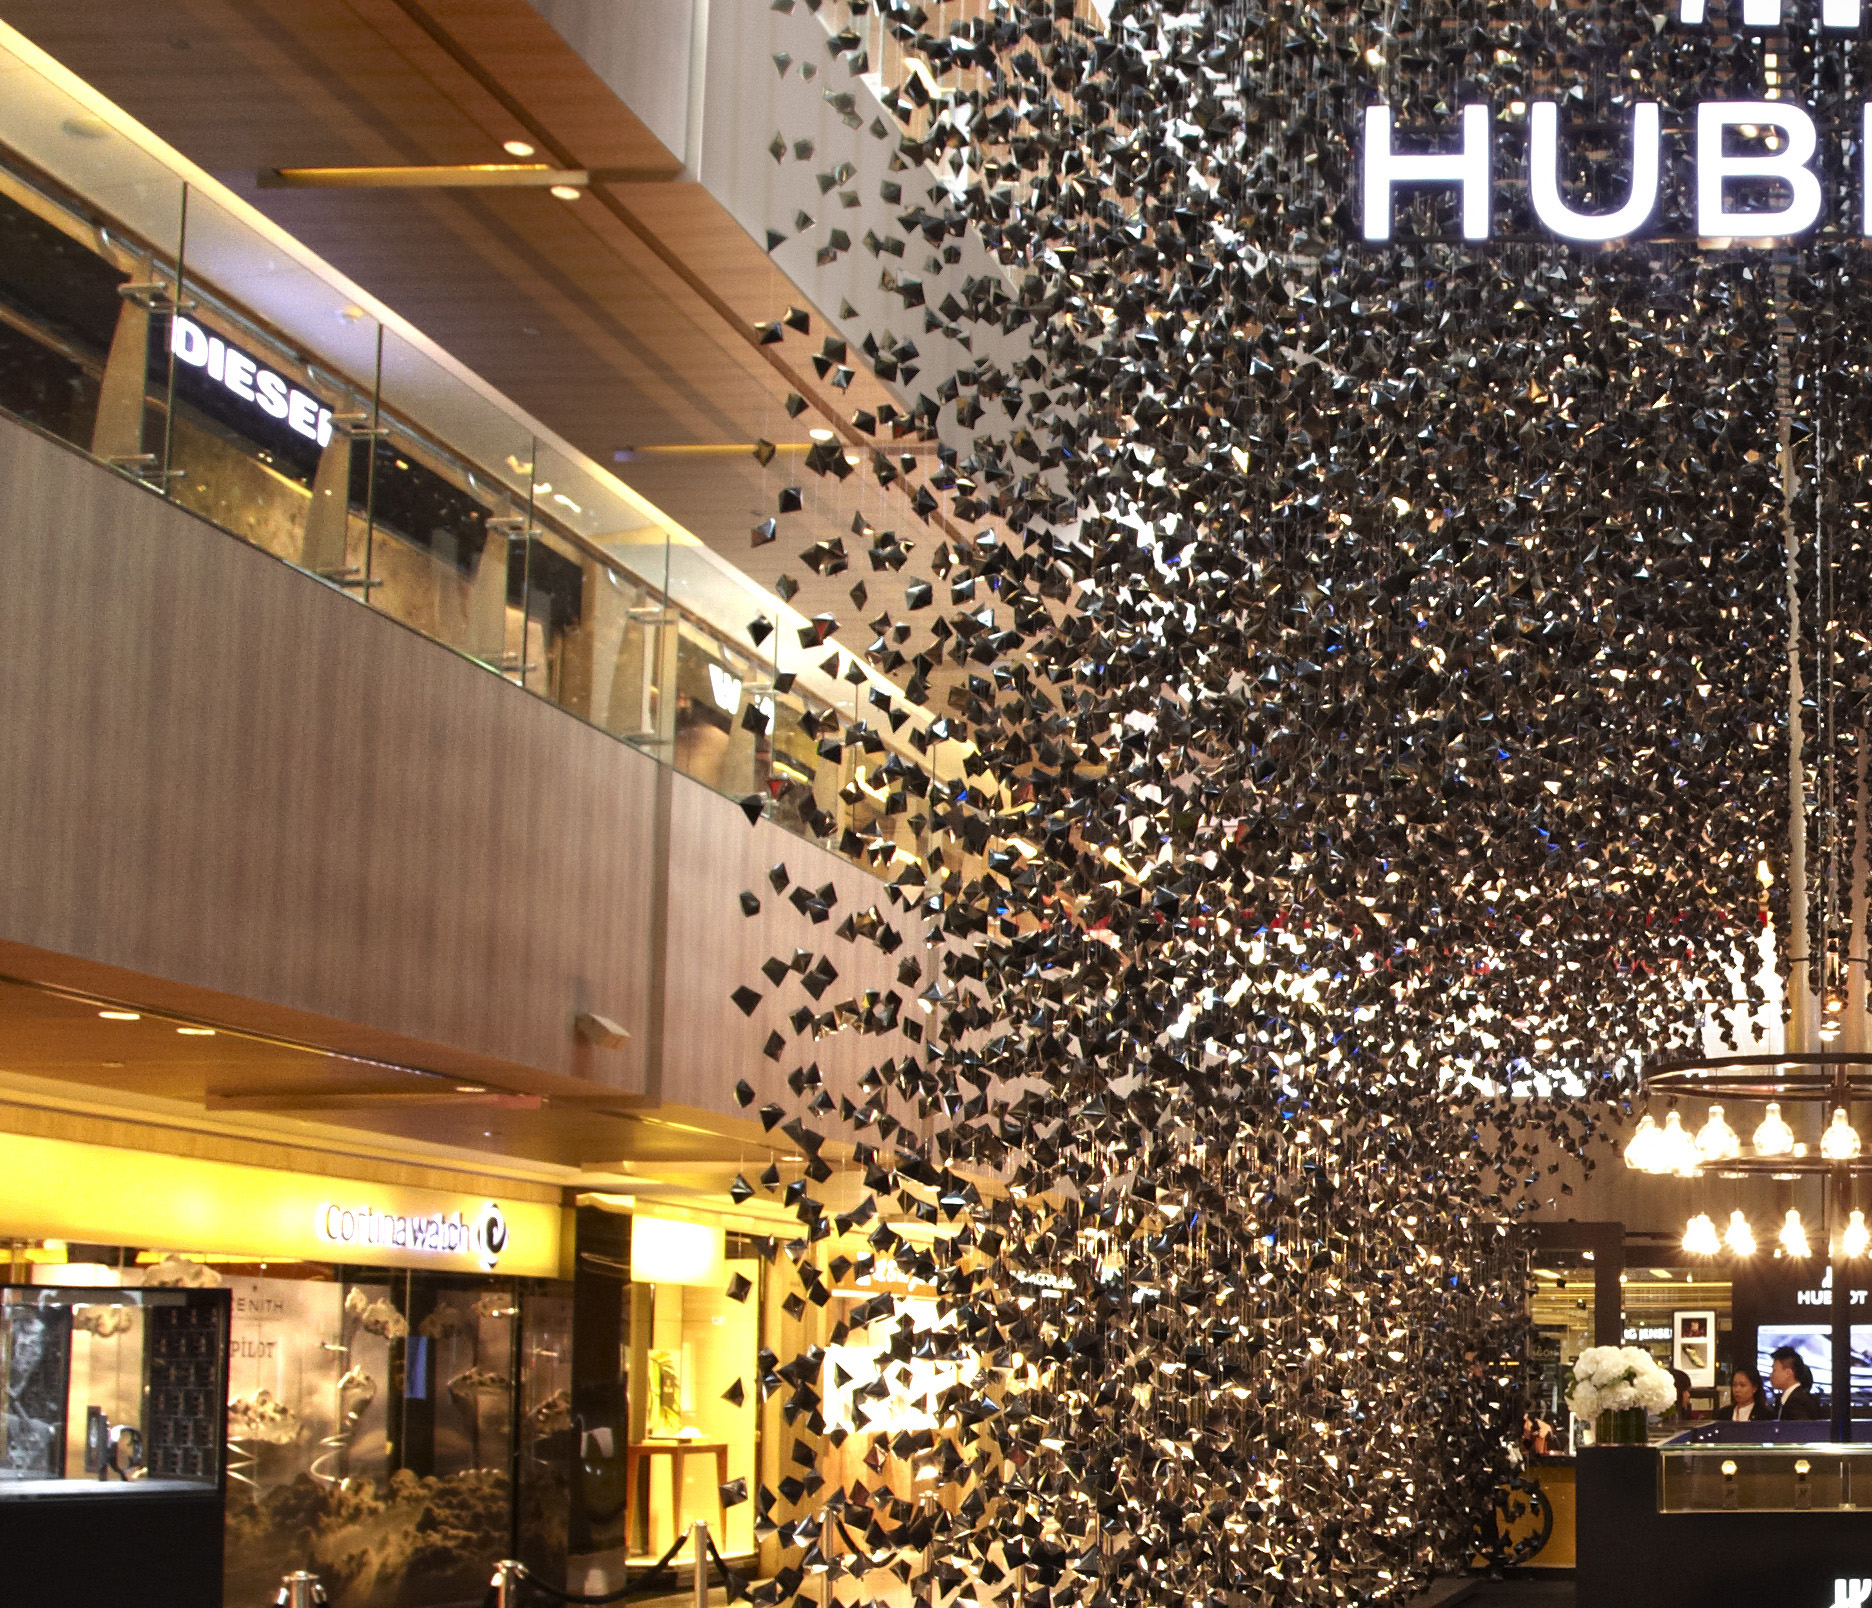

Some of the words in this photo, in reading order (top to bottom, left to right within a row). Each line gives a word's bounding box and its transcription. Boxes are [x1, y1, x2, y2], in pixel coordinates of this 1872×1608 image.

[236, 1297, 283, 1312] ENITH
[1797, 1290, 1868, 1305] HUBOT
[1639, 1328, 1673, 1341] JENSE
